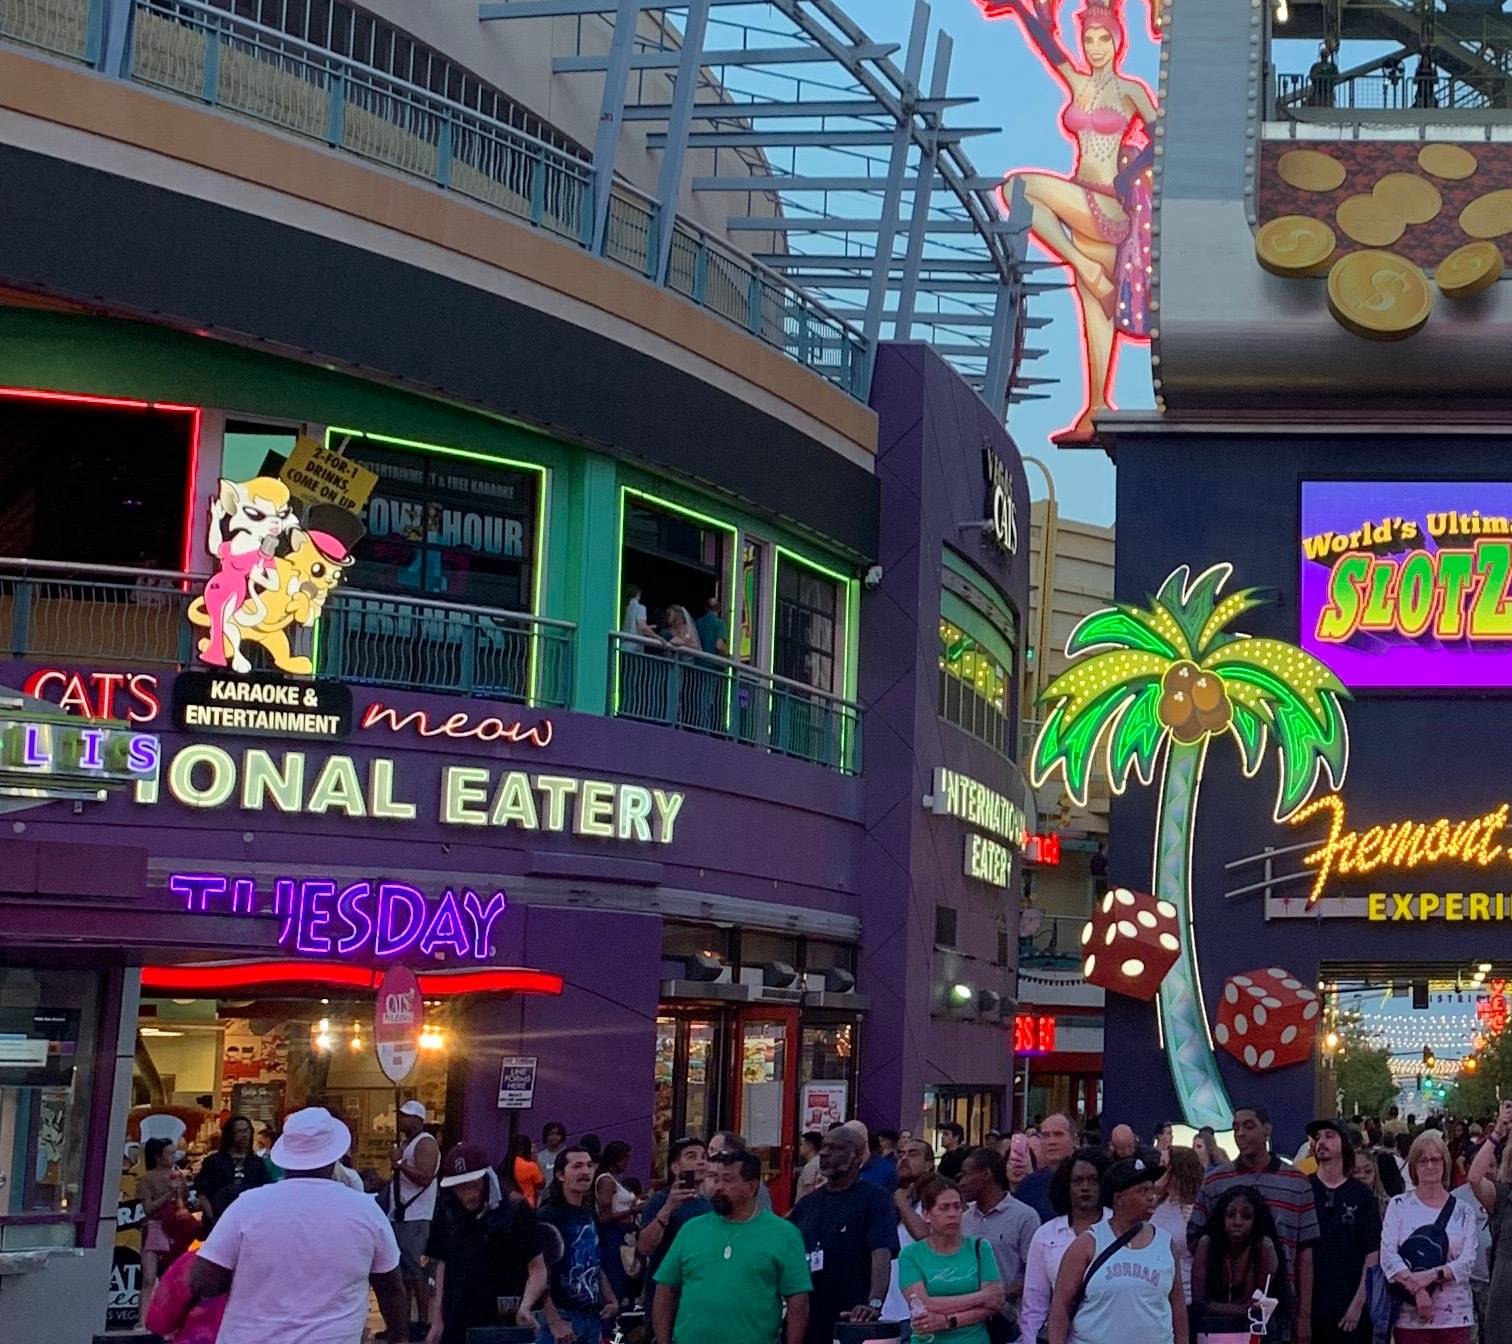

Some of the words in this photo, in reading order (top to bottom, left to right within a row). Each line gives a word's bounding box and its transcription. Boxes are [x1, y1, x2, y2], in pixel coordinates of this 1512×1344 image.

[286, 466, 320, 493] COME
[319, 483, 338, 503] ON
[306, 460, 351, 493] DRINKS,
[441, 508, 524, 556] HOUR
[1302, 515, 1418, 562] World's
[24, 668, 160, 723] CAT'S
[210, 679, 301, 707] KARAOKE
[303, 687, 318, 707] &
[185, 704, 341, 735] ENTERTAINMENT
[361, 703, 553, 748] meow
[440, 765, 686, 844] EATERY
[1290, 792, 1510, 912] Fremont
[1103, 1261, 1161, 1288] JORDAN
